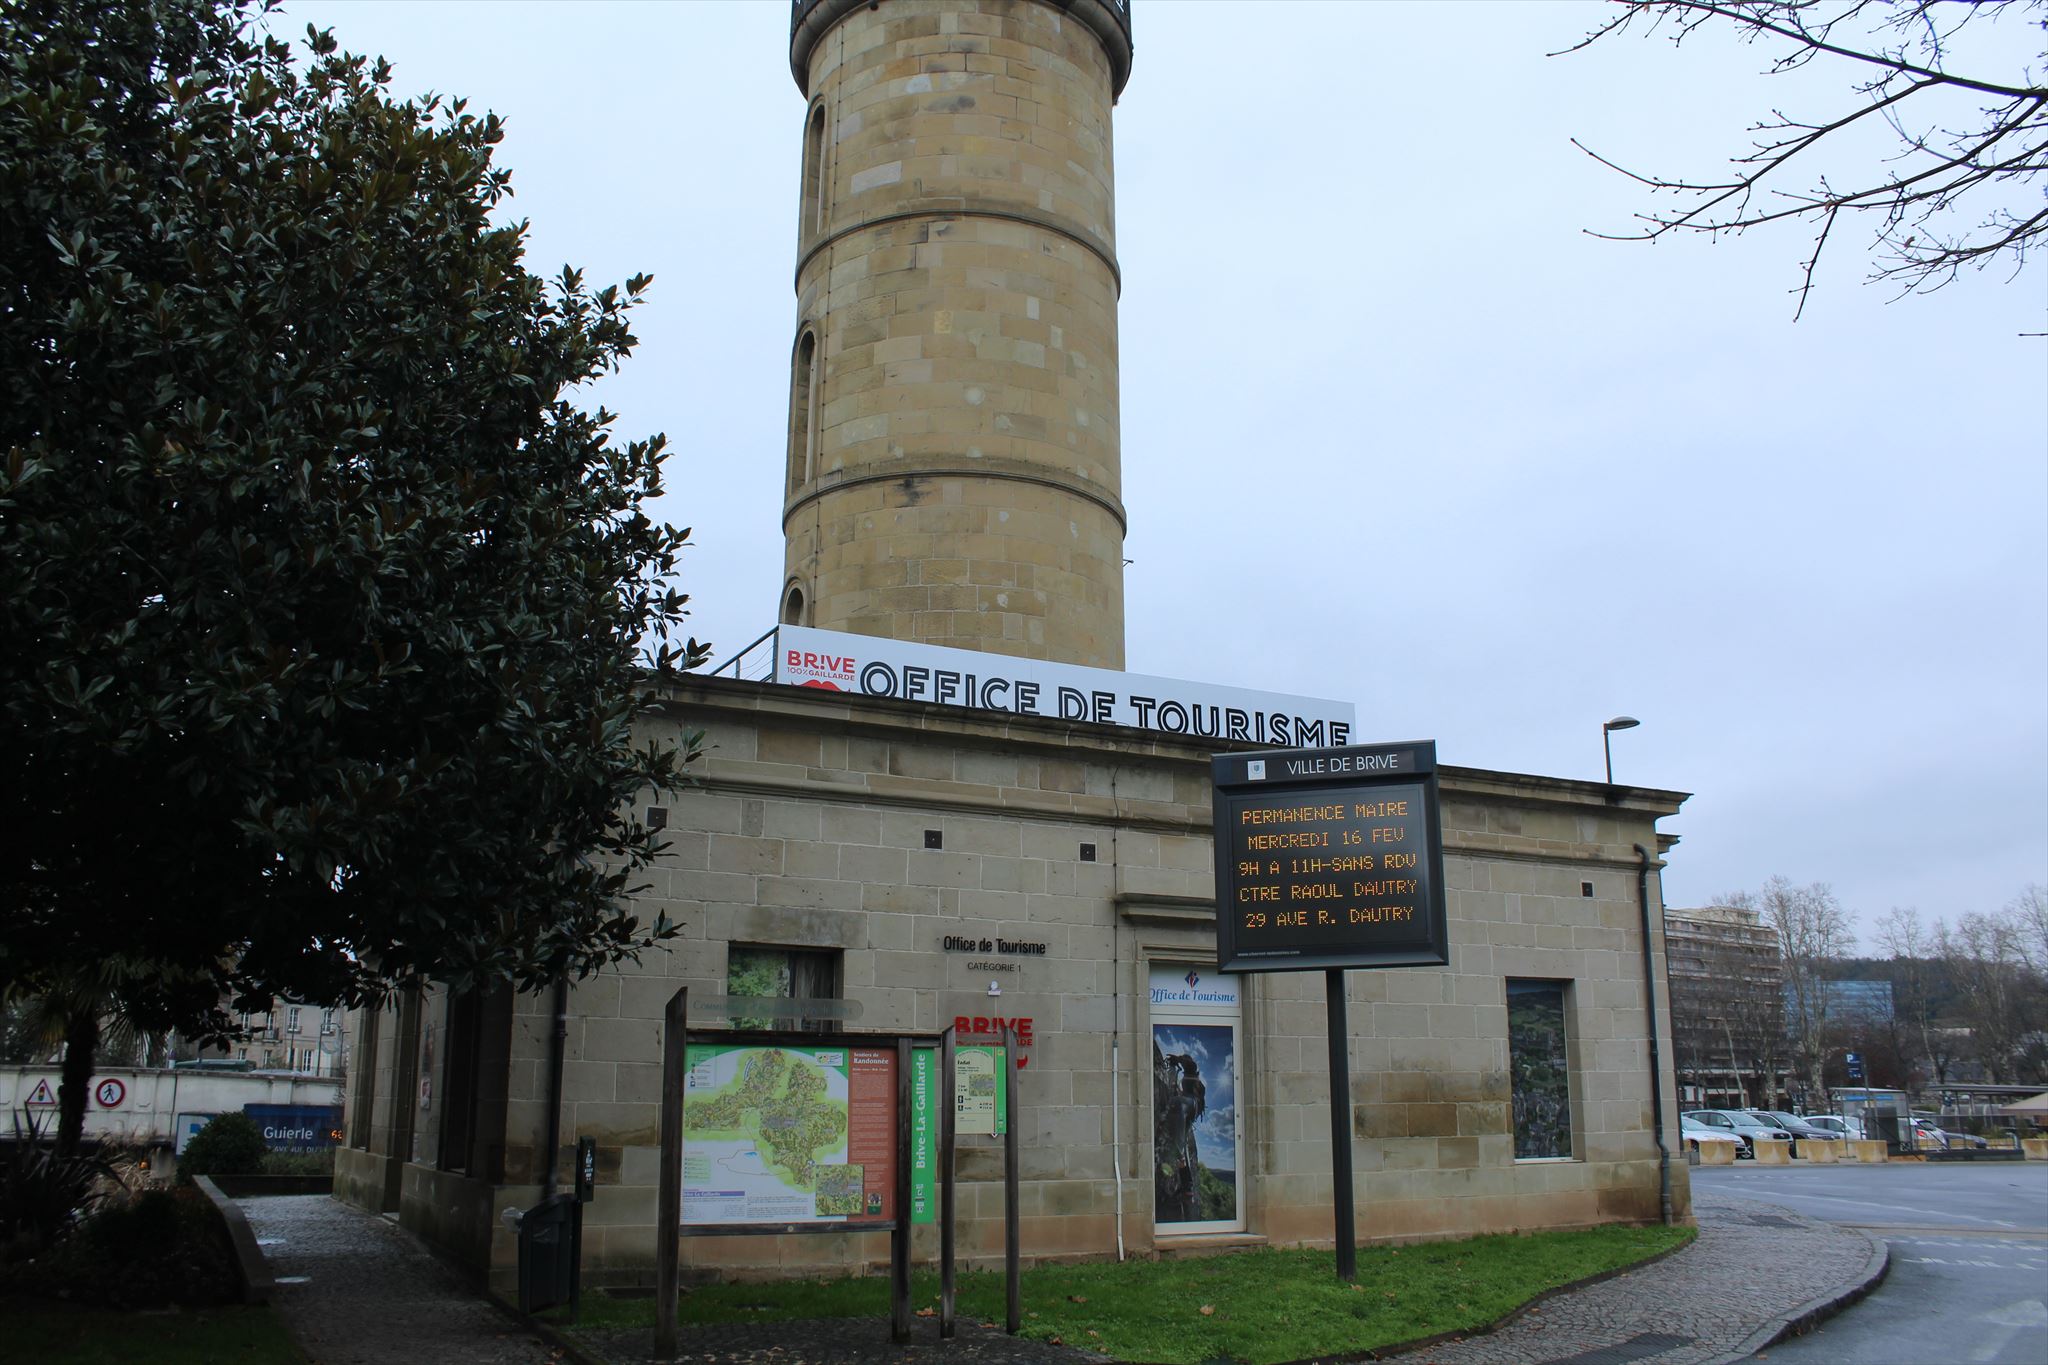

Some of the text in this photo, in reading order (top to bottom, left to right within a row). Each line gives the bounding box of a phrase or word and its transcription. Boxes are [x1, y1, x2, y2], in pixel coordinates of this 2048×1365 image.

[787, 650, 855, 674] BR!VE
[860, 661, 1350, 748] OFFICE DE TOURISME
[1287, 753, 1399, 775] VILLE DE BRIVE
[1242, 801, 1408, 825] PERMANENCE MAIRE
[1248, 827, 1405, 850] MERCREDI 16 FEV
[1238, 853, 1417, 876] 9H A 11H-SANS RDV
[1239, 879, 1417, 902] CTRE RAOUL DAUTRY
[1245, 906, 1414, 929] 29 AVE R. DAUTRY
[943, 935, 1046, 955] Office de Tourisme
[967, 960, 1015, 972] CATÉGORIE
[1179, 989, 1191, 1001] de
[1191, 989, 1235, 1002] Tourisme
[915, 1053, 926, 1169] Brive-La-Gaillarde
[263, 1126, 313, 1140] Guierle
